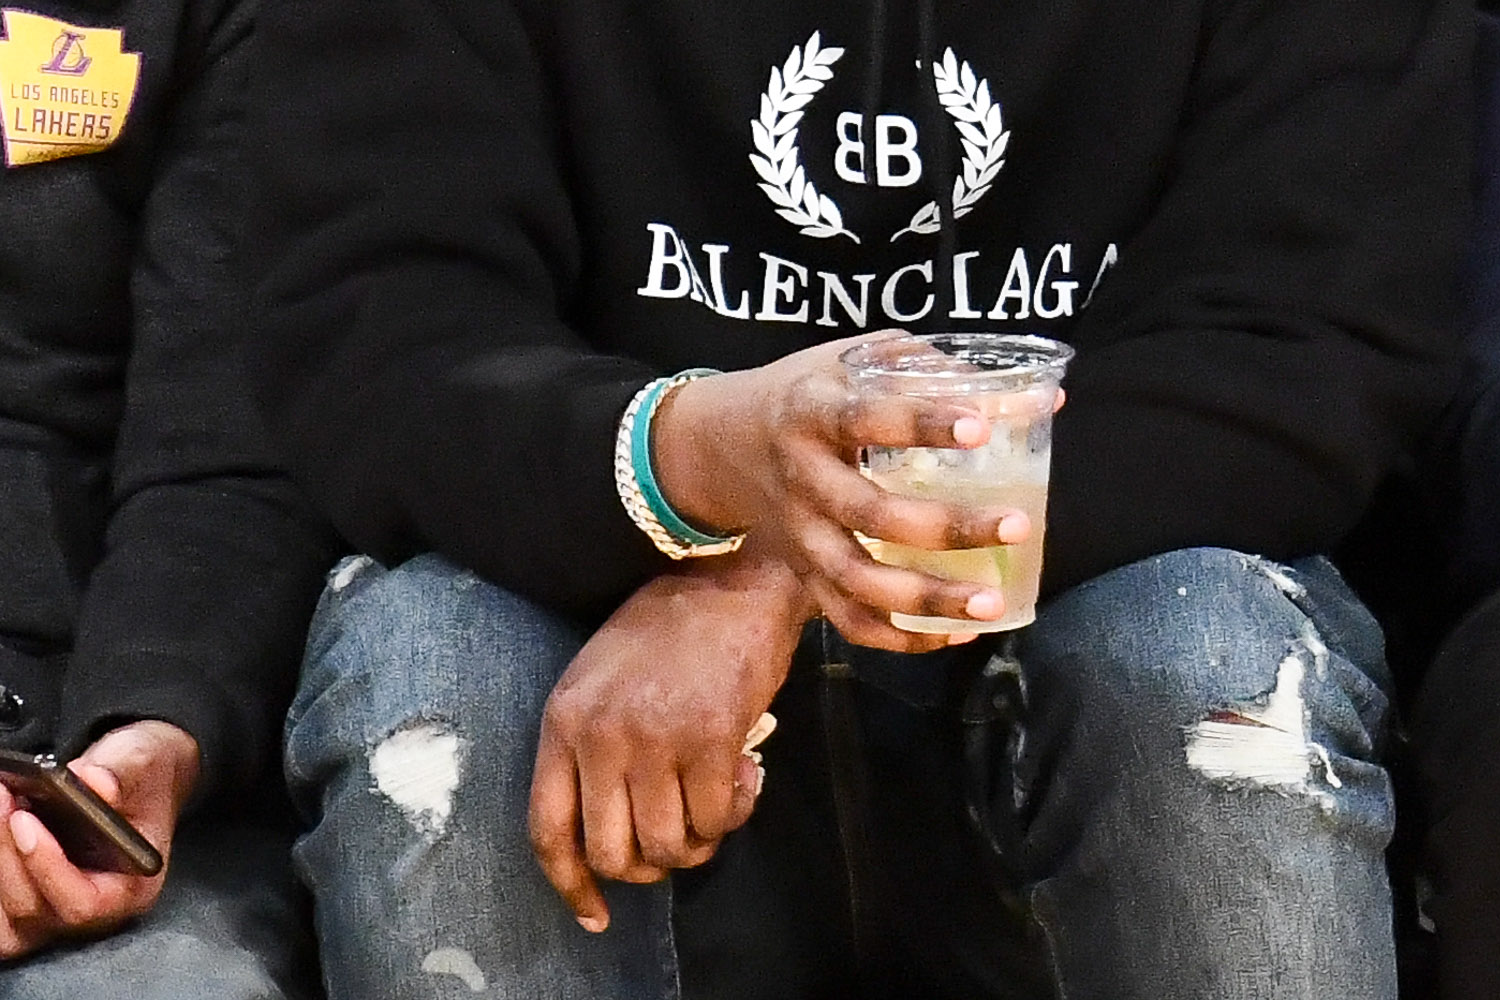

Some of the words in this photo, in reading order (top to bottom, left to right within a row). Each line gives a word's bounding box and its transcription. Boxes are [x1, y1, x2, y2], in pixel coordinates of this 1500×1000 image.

[11, 83, 41, 100] LOS
[50, 86, 119, 109] ANGELES
[15, 107, 113, 140] LAKERS
